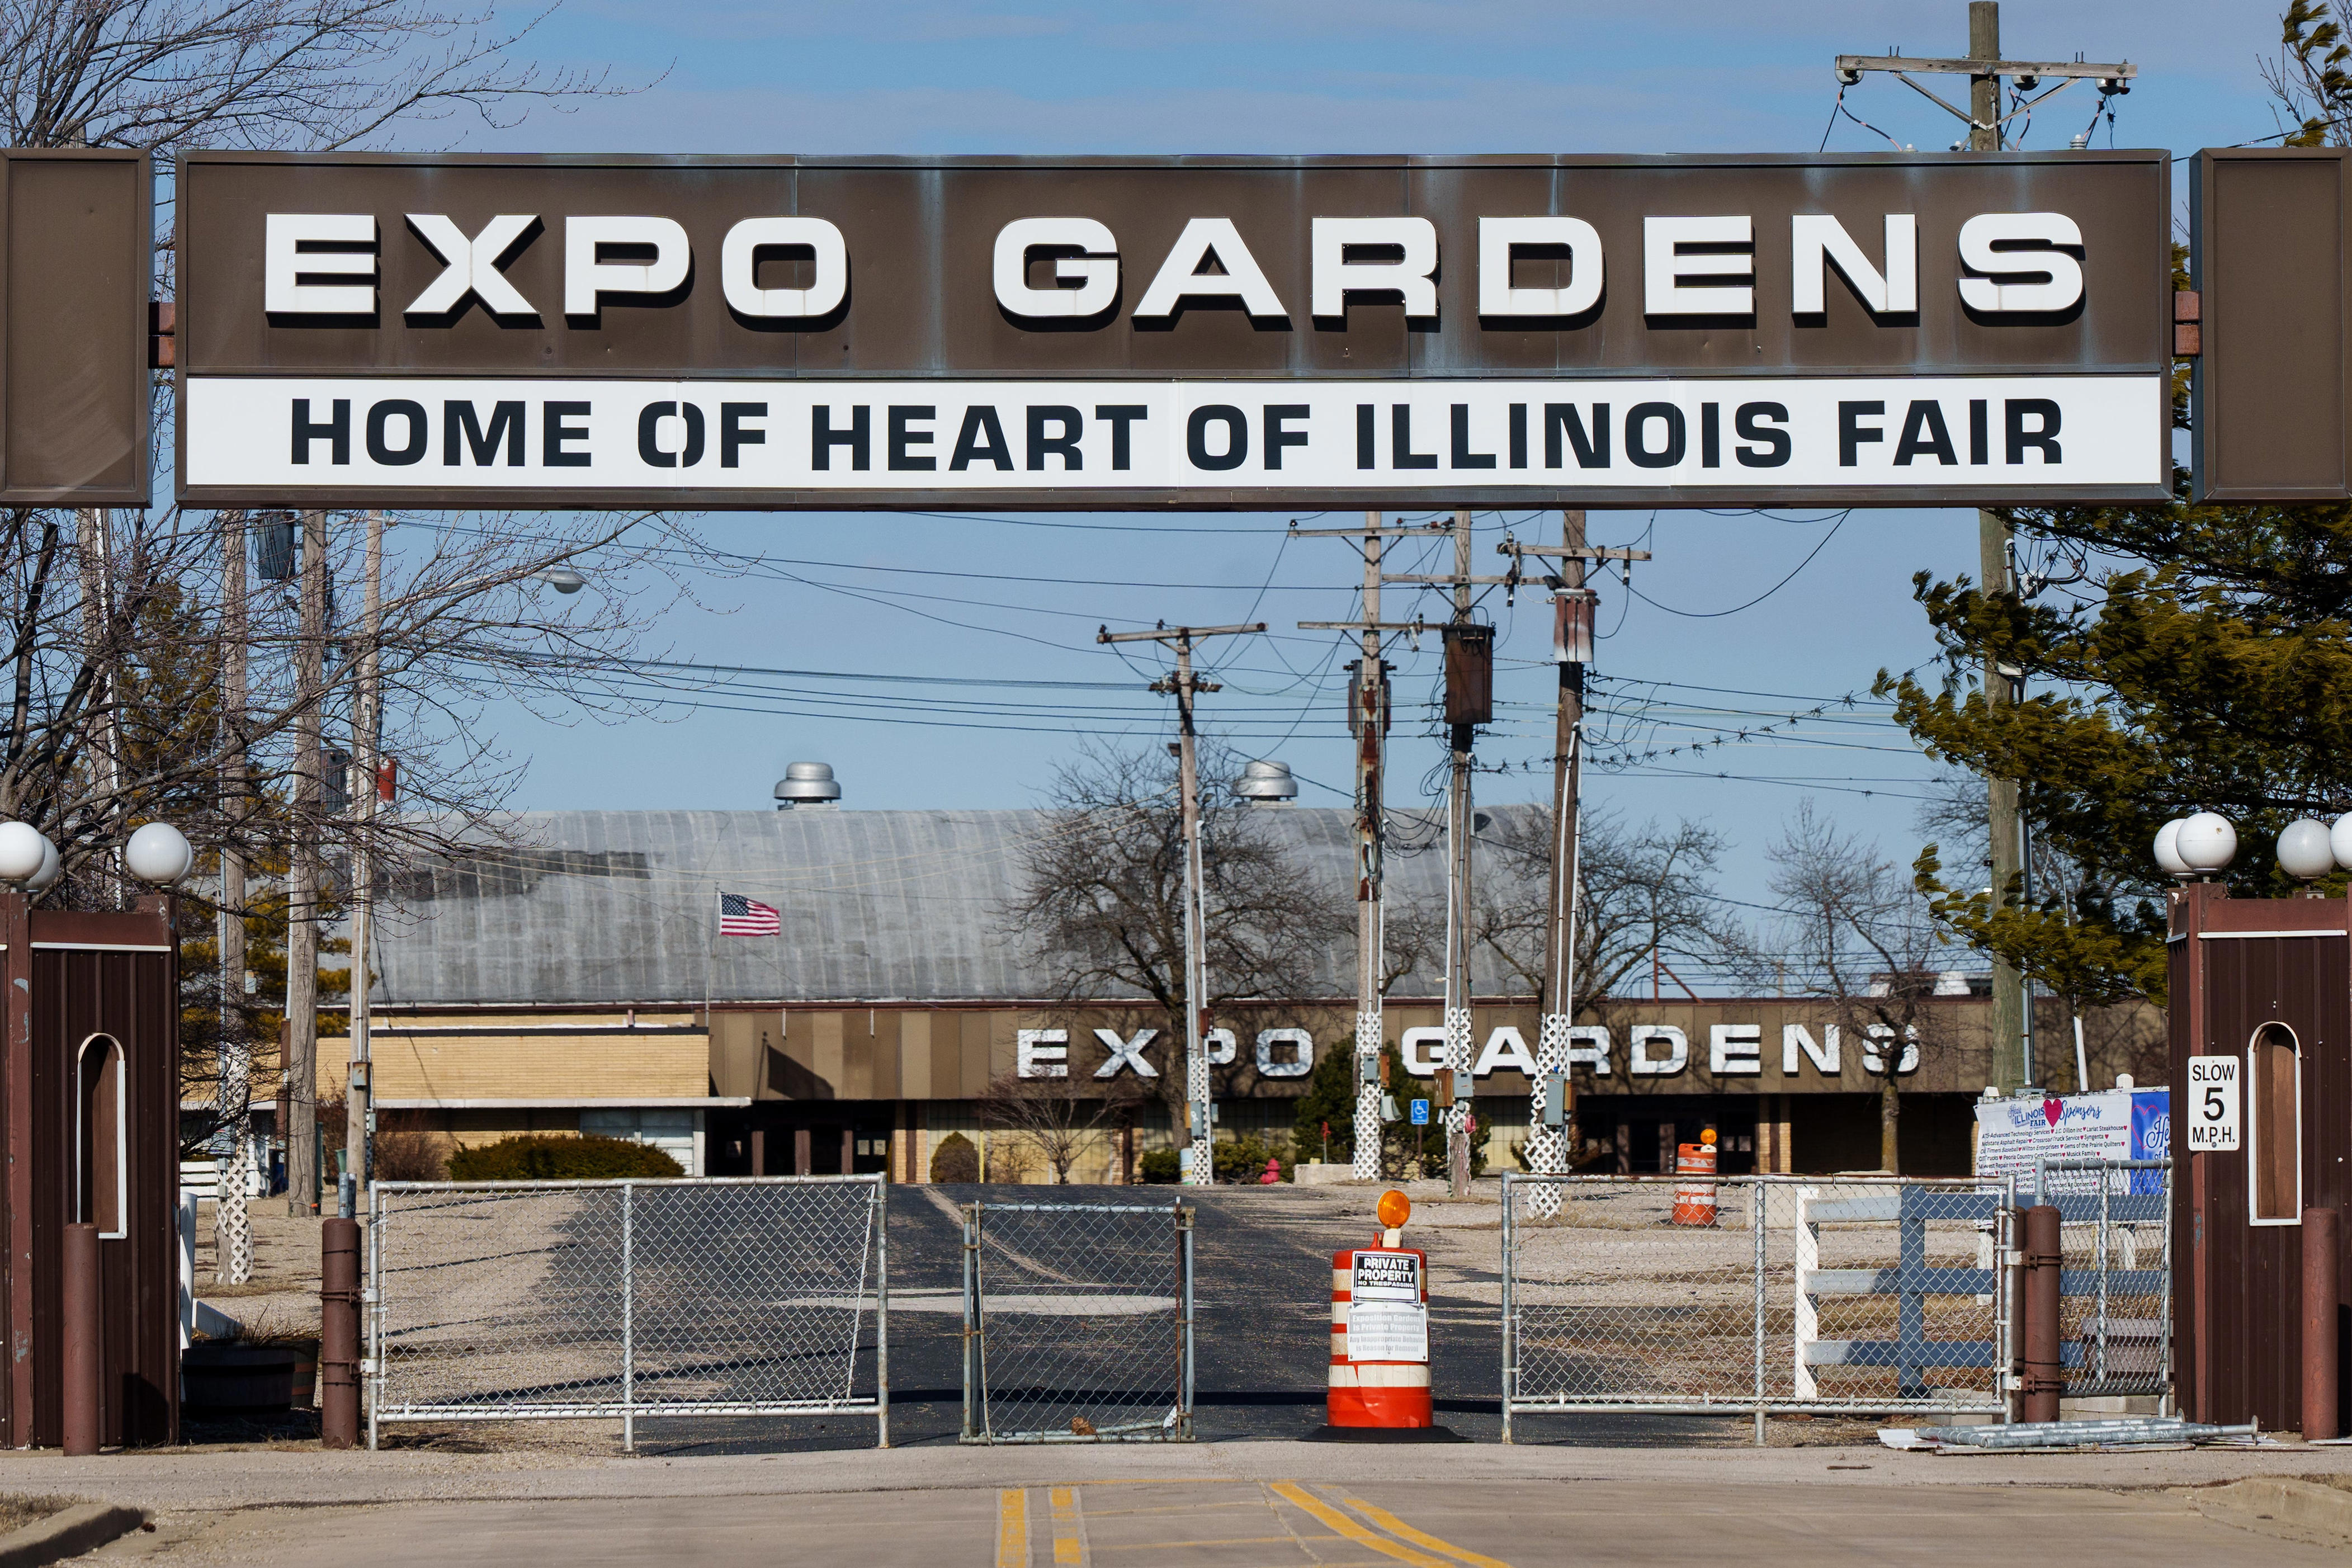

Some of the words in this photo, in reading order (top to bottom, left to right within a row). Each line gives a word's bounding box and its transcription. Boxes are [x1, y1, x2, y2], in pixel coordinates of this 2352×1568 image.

[266, 214, 846, 316] EXPO
[994, 212, 2082, 316] GARDENS
[292, 398, 592, 467] HOME
[637, 401, 768, 468] OF
[811, 405, 1147, 471] HEART
[1187, 404, 1310, 471] OF
[1357, 402, 1791, 470] ILLINOIS
[1838, 398, 2062, 467] FAIR
[1017, 1028, 1314, 1078] EXPO
[1402, 1023, 1920, 1075] GARDENS
[2192, 1064, 2235, 1081] SLOW
[2059, 1100, 2103, 1126] Sponsors
[2203, 1087, 2225, 1122] 5
[2014, 1107, 2045, 1126] ILLINOIS
[2193, 1126, 2236, 1144] M.P.H.
[1363, 1257, 1410, 1271] PRIVATE
[1357, 1268, 1414, 1282] PROPERTY
[1353, 1314, 1392, 1323] Exposition
[1390, 1324, 1420, 1333] Property
